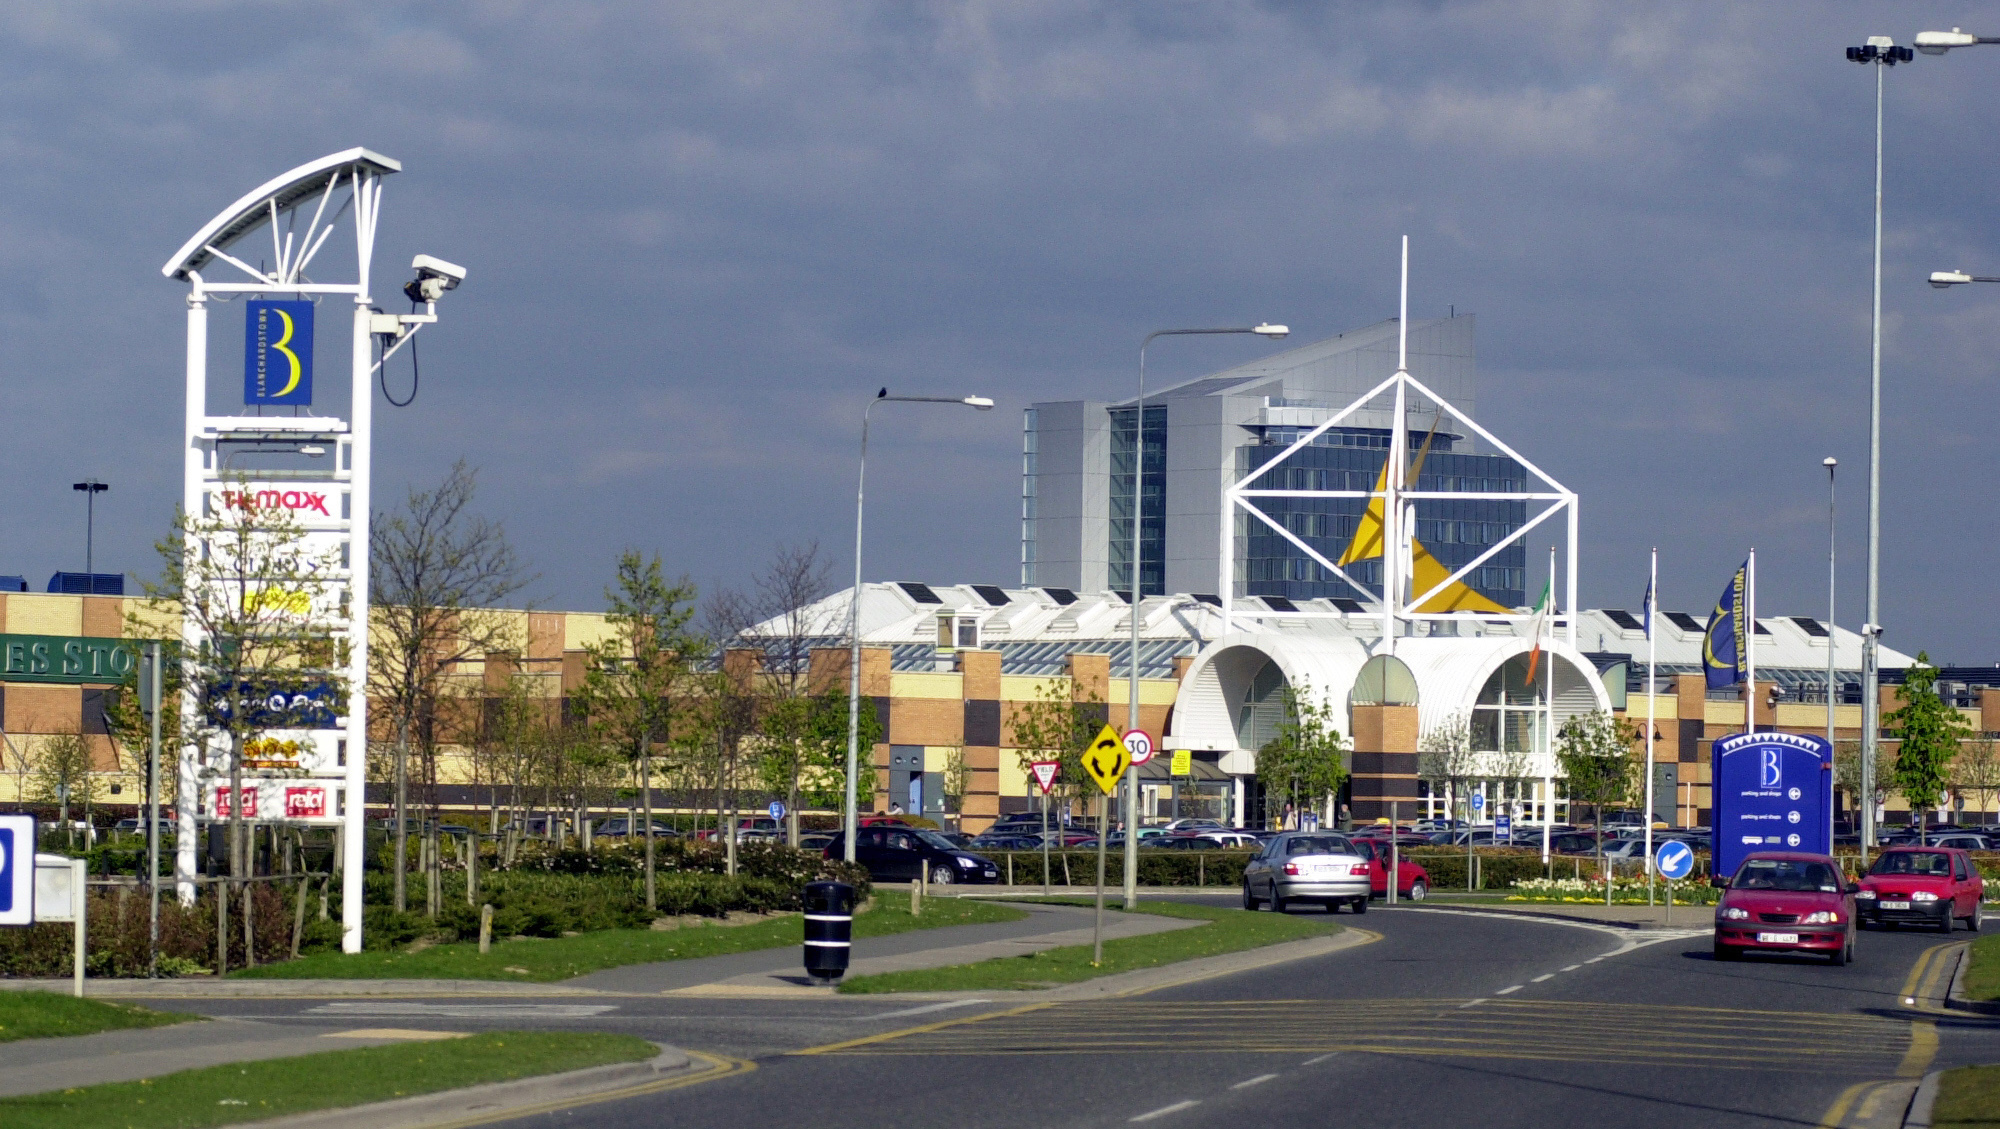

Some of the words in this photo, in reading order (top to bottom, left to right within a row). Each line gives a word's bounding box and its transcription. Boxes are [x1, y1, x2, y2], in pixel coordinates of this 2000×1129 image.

[257, 308, 267, 398] BLANCHARDSTOWN
[63, 640, 135, 676] STO
[1128, 739, 1148, 755] 30
[288, 790, 324, 808] reid
